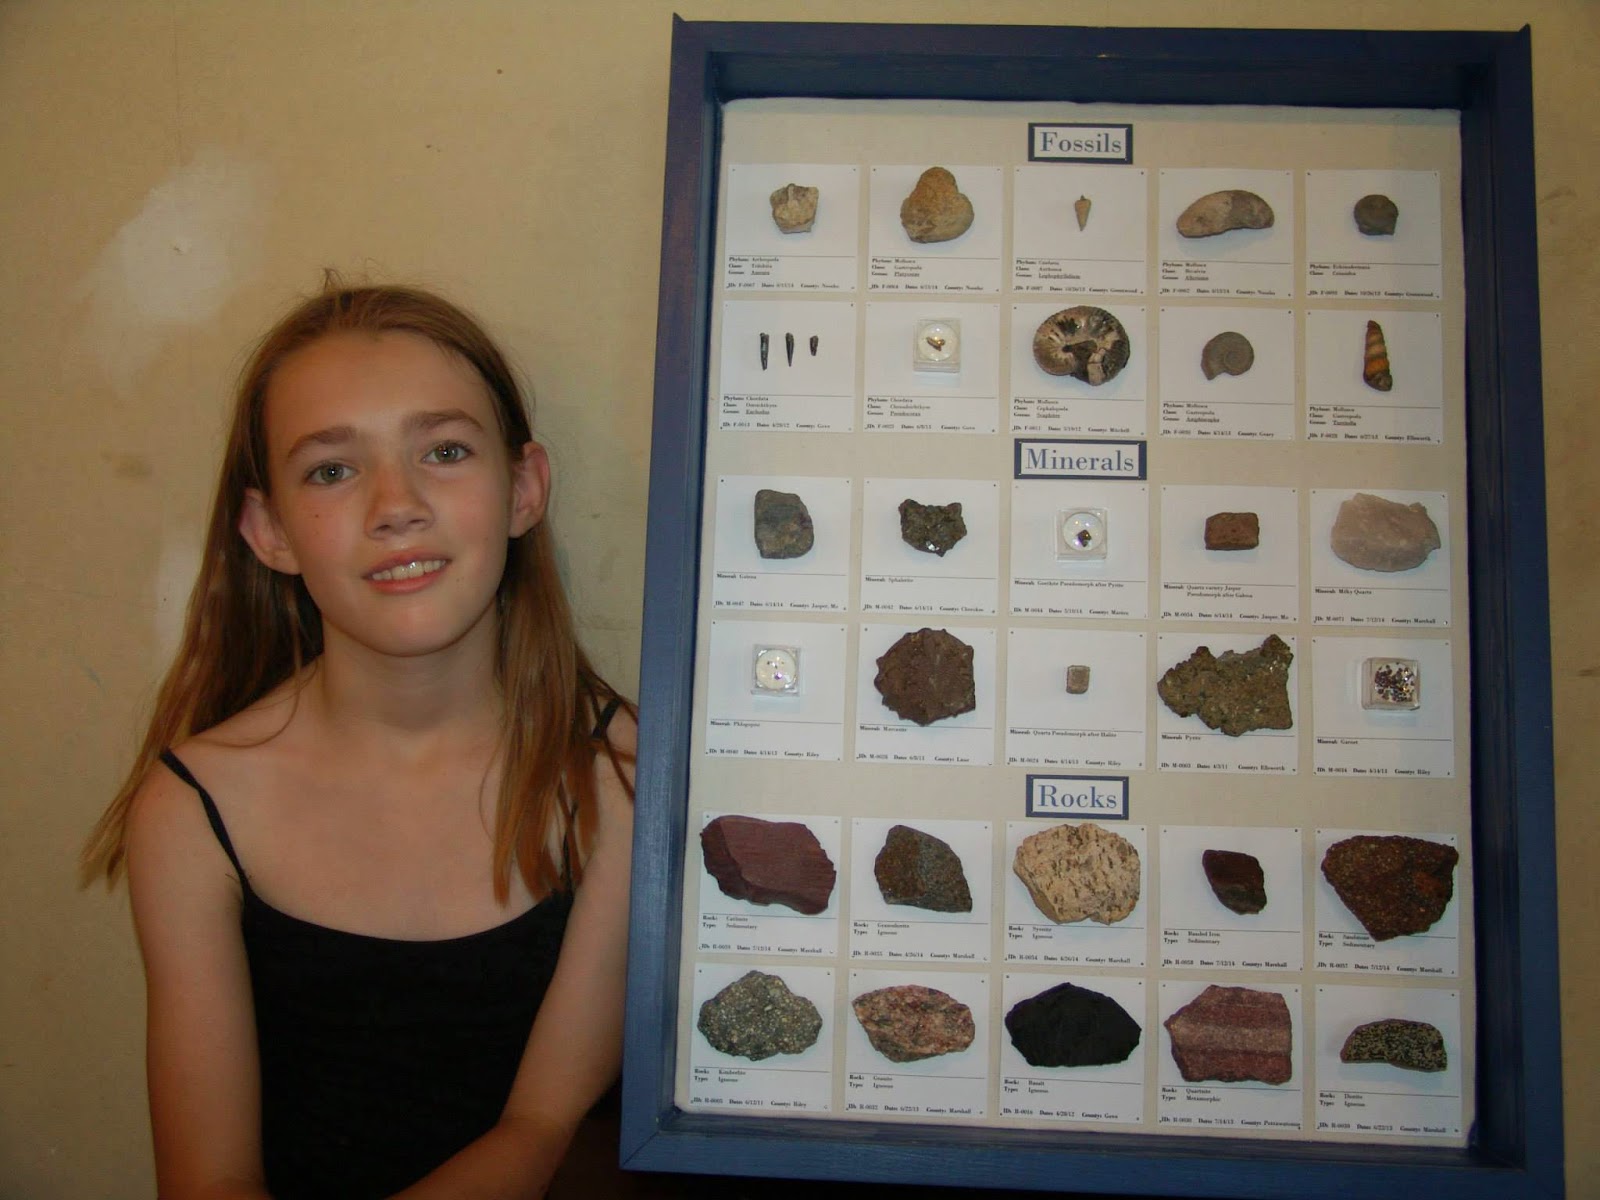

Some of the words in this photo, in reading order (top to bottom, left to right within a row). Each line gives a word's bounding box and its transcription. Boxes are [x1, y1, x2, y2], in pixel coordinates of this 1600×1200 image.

[1039, 131, 1122, 153] Fossils
[1025, 448, 1134, 472] Minerals
[1037, 784, 1117, 809] Rocks
